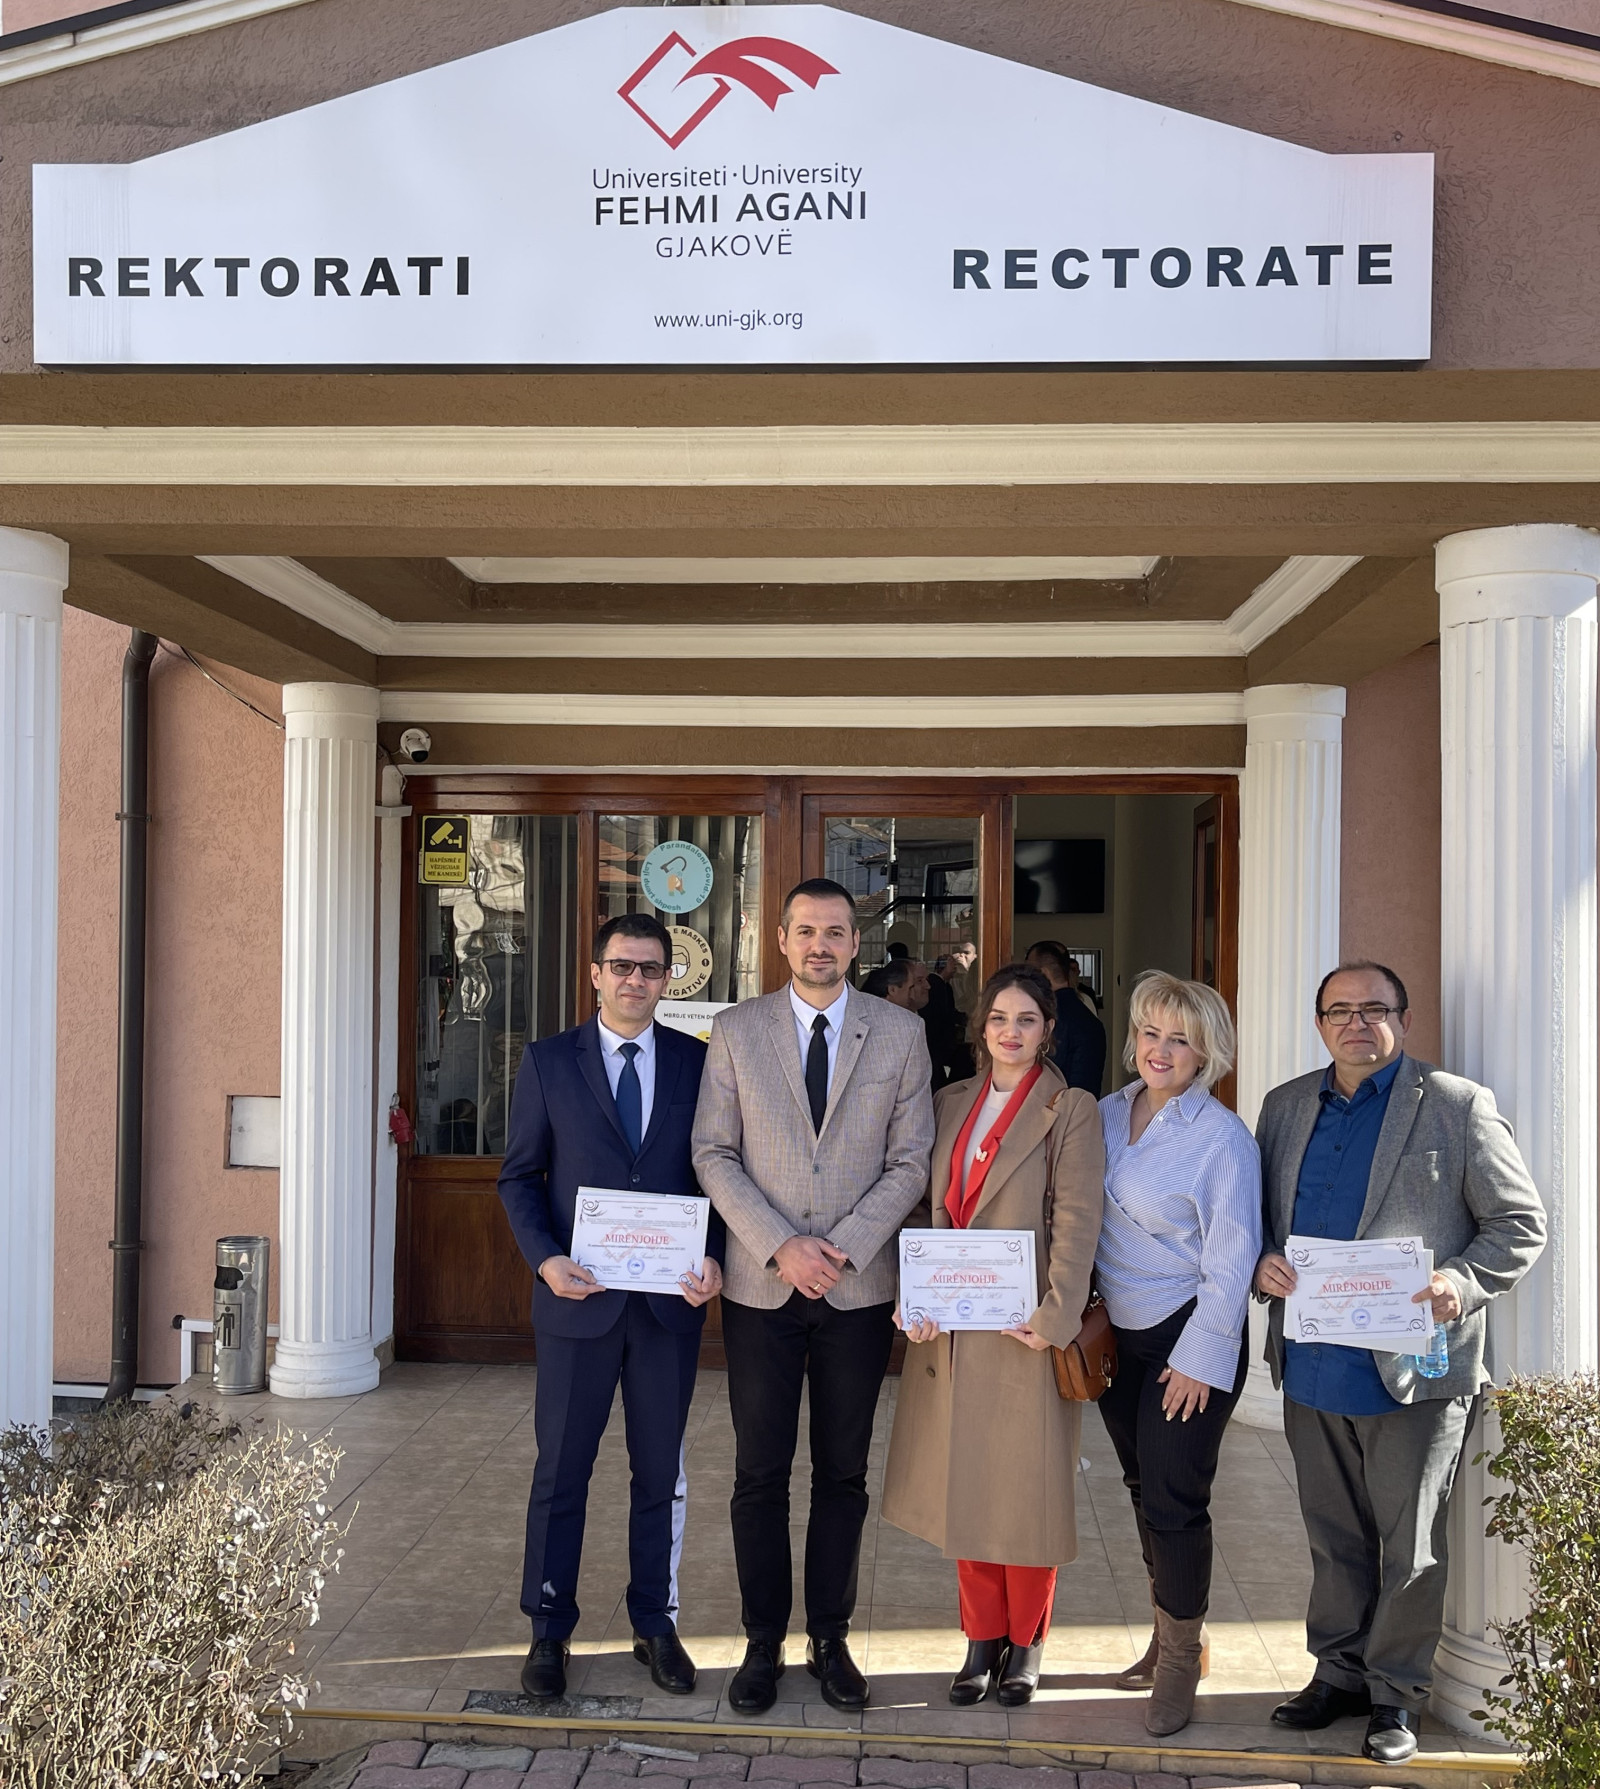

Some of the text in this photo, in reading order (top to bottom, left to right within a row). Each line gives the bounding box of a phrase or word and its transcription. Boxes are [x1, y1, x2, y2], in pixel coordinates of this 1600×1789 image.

[592, 163, 862, 189] Universiteti University
[595, 190, 867, 225] FEHMI AGANI
[655, 228, 793, 258] GJAKOVË
[67, 255, 470, 298] REKTORATI
[951, 243, 1395, 291] RECTORATE
[653, 309, 803, 331] www.uni-gjk.org
[660, 842, 708, 865] Parandaloni
[669, 972, 707, 996] IGATIVE
[605, 1233, 670, 1245] MIRËNJOHJE
[933, 1273, 998, 1284] MIRËNJOHJE
[1322, 1280, 1392, 1294] MIRËNJOHJE
